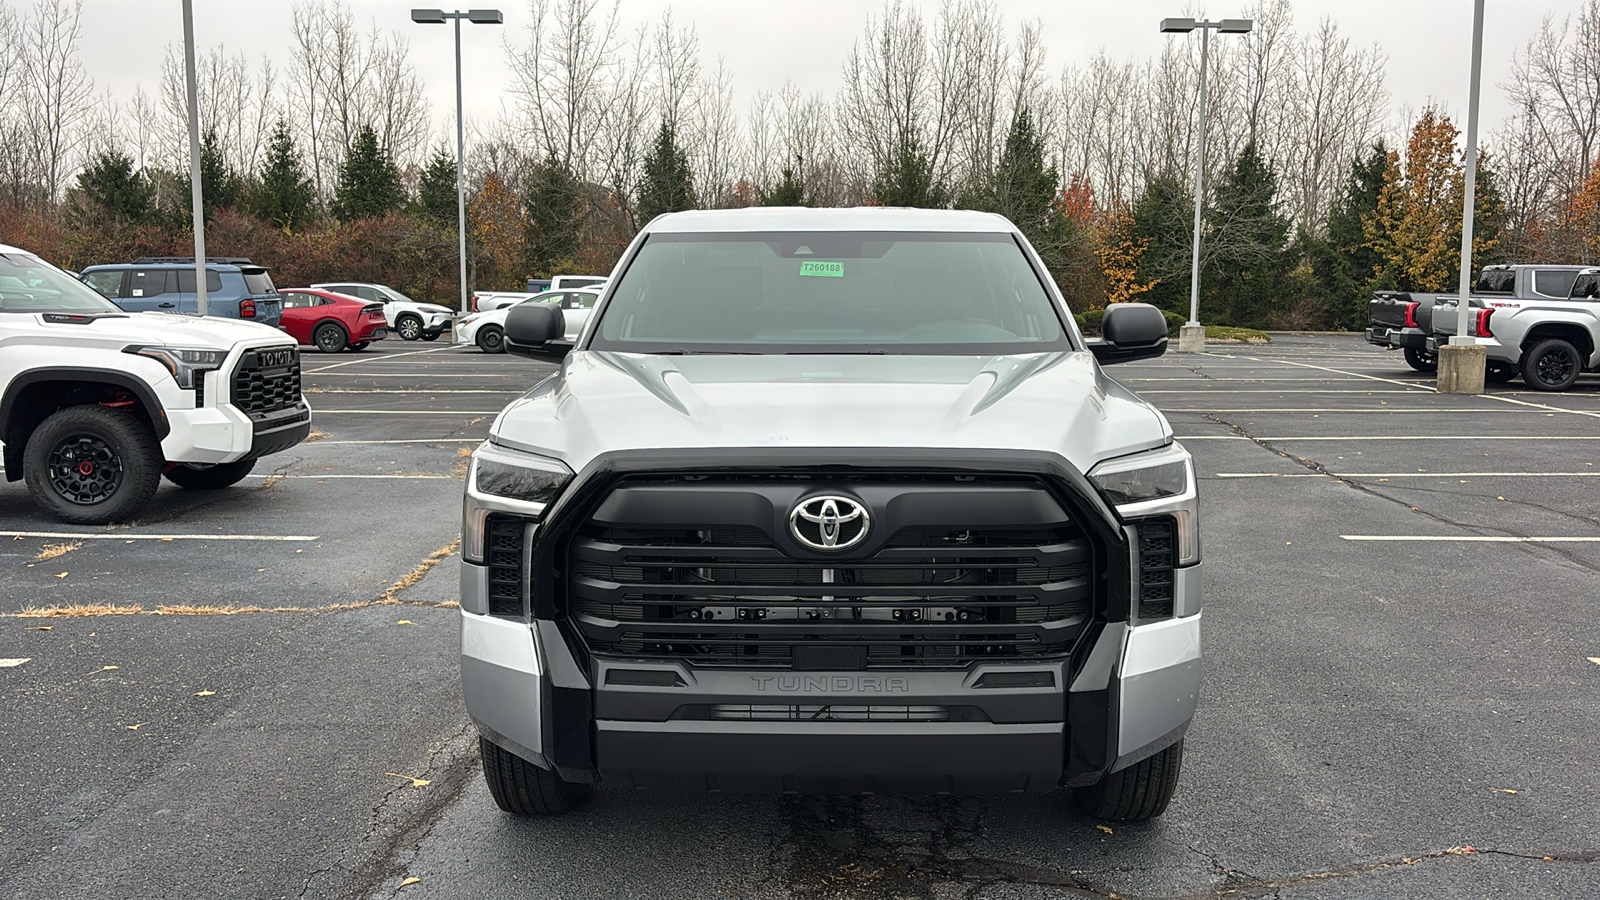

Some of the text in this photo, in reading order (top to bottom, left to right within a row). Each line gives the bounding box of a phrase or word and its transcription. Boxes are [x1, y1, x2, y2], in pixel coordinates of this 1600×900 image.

[803, 263, 841, 272] T260188
[261, 350, 293, 366] TOYOTA
[750, 675, 909, 693] TUNDRA
